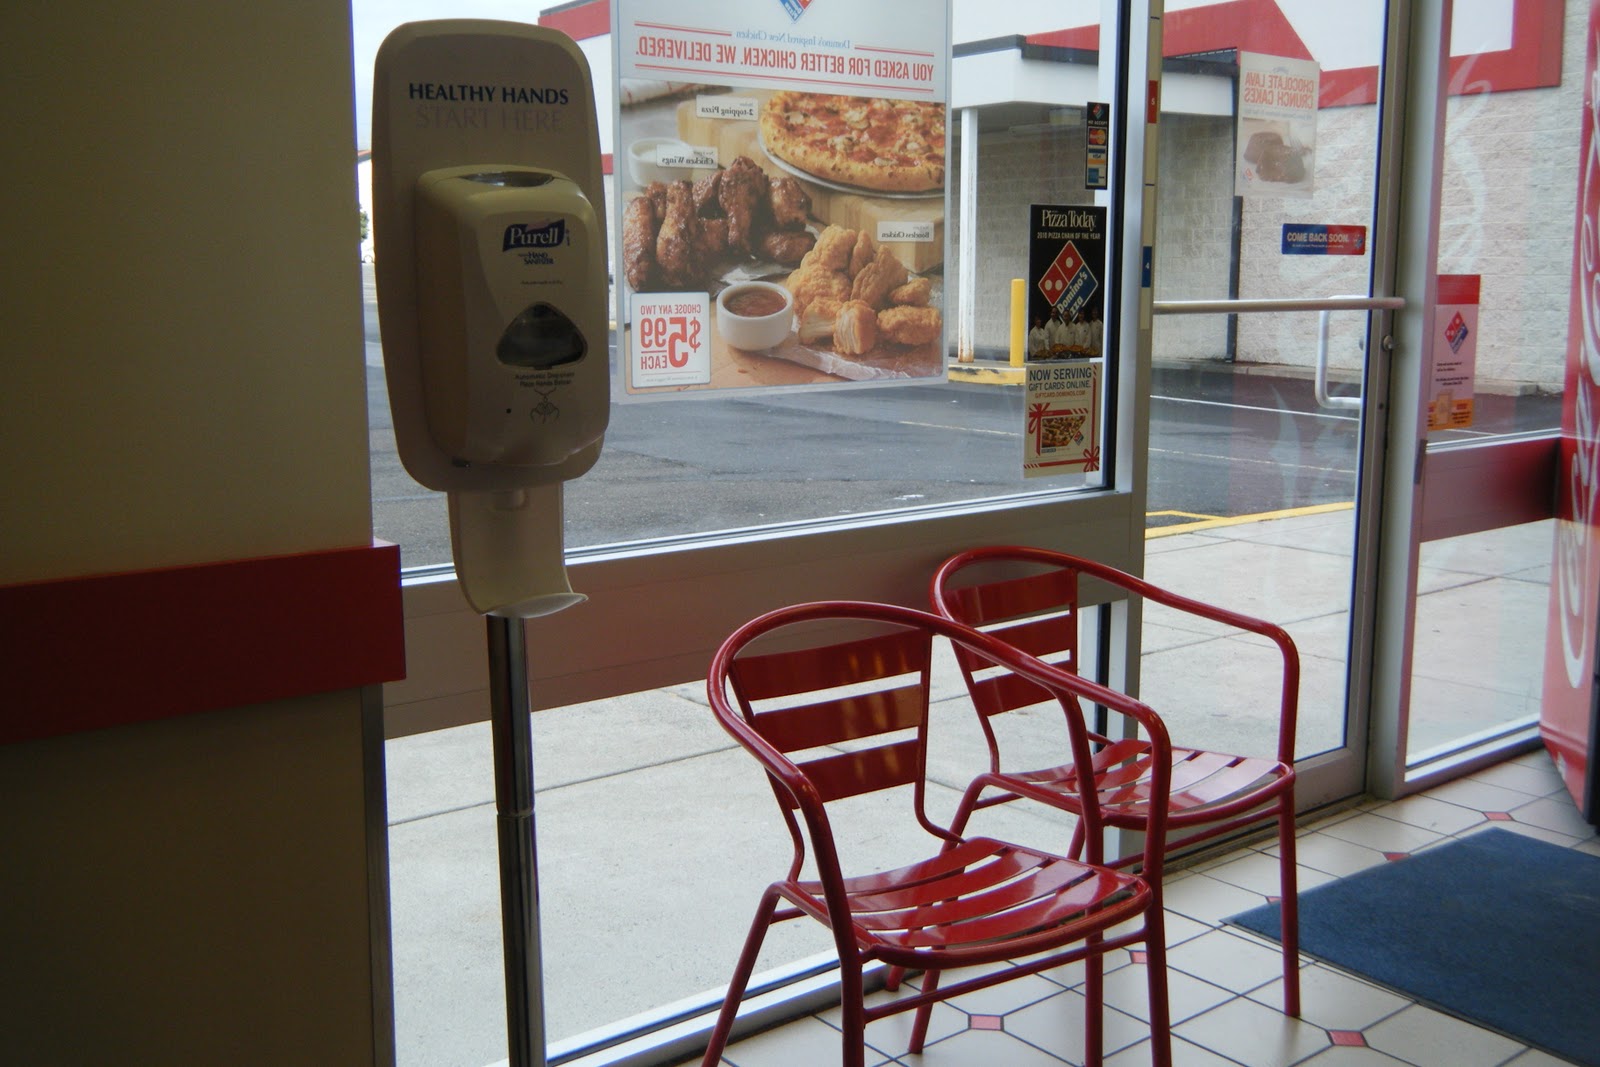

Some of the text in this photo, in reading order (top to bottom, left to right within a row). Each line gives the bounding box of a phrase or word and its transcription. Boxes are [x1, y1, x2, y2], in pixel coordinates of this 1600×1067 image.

[409, 83, 568, 105] HEALTHY HANDS
[415, 105, 562, 131] START HERE
[1042, 210, 1096, 231] Pizza Today
[510, 227, 558, 245] Purell
[1287, 232, 1307, 242] COME
[1309, 233, 1328, 242] BACK
[1057, 271, 1088, 314] Domino's
[1029, 368, 1092, 381] NOW SERVING
[1029, 383, 1043, 391] GIFT
[1044, 381, 1065, 390] CARDS
